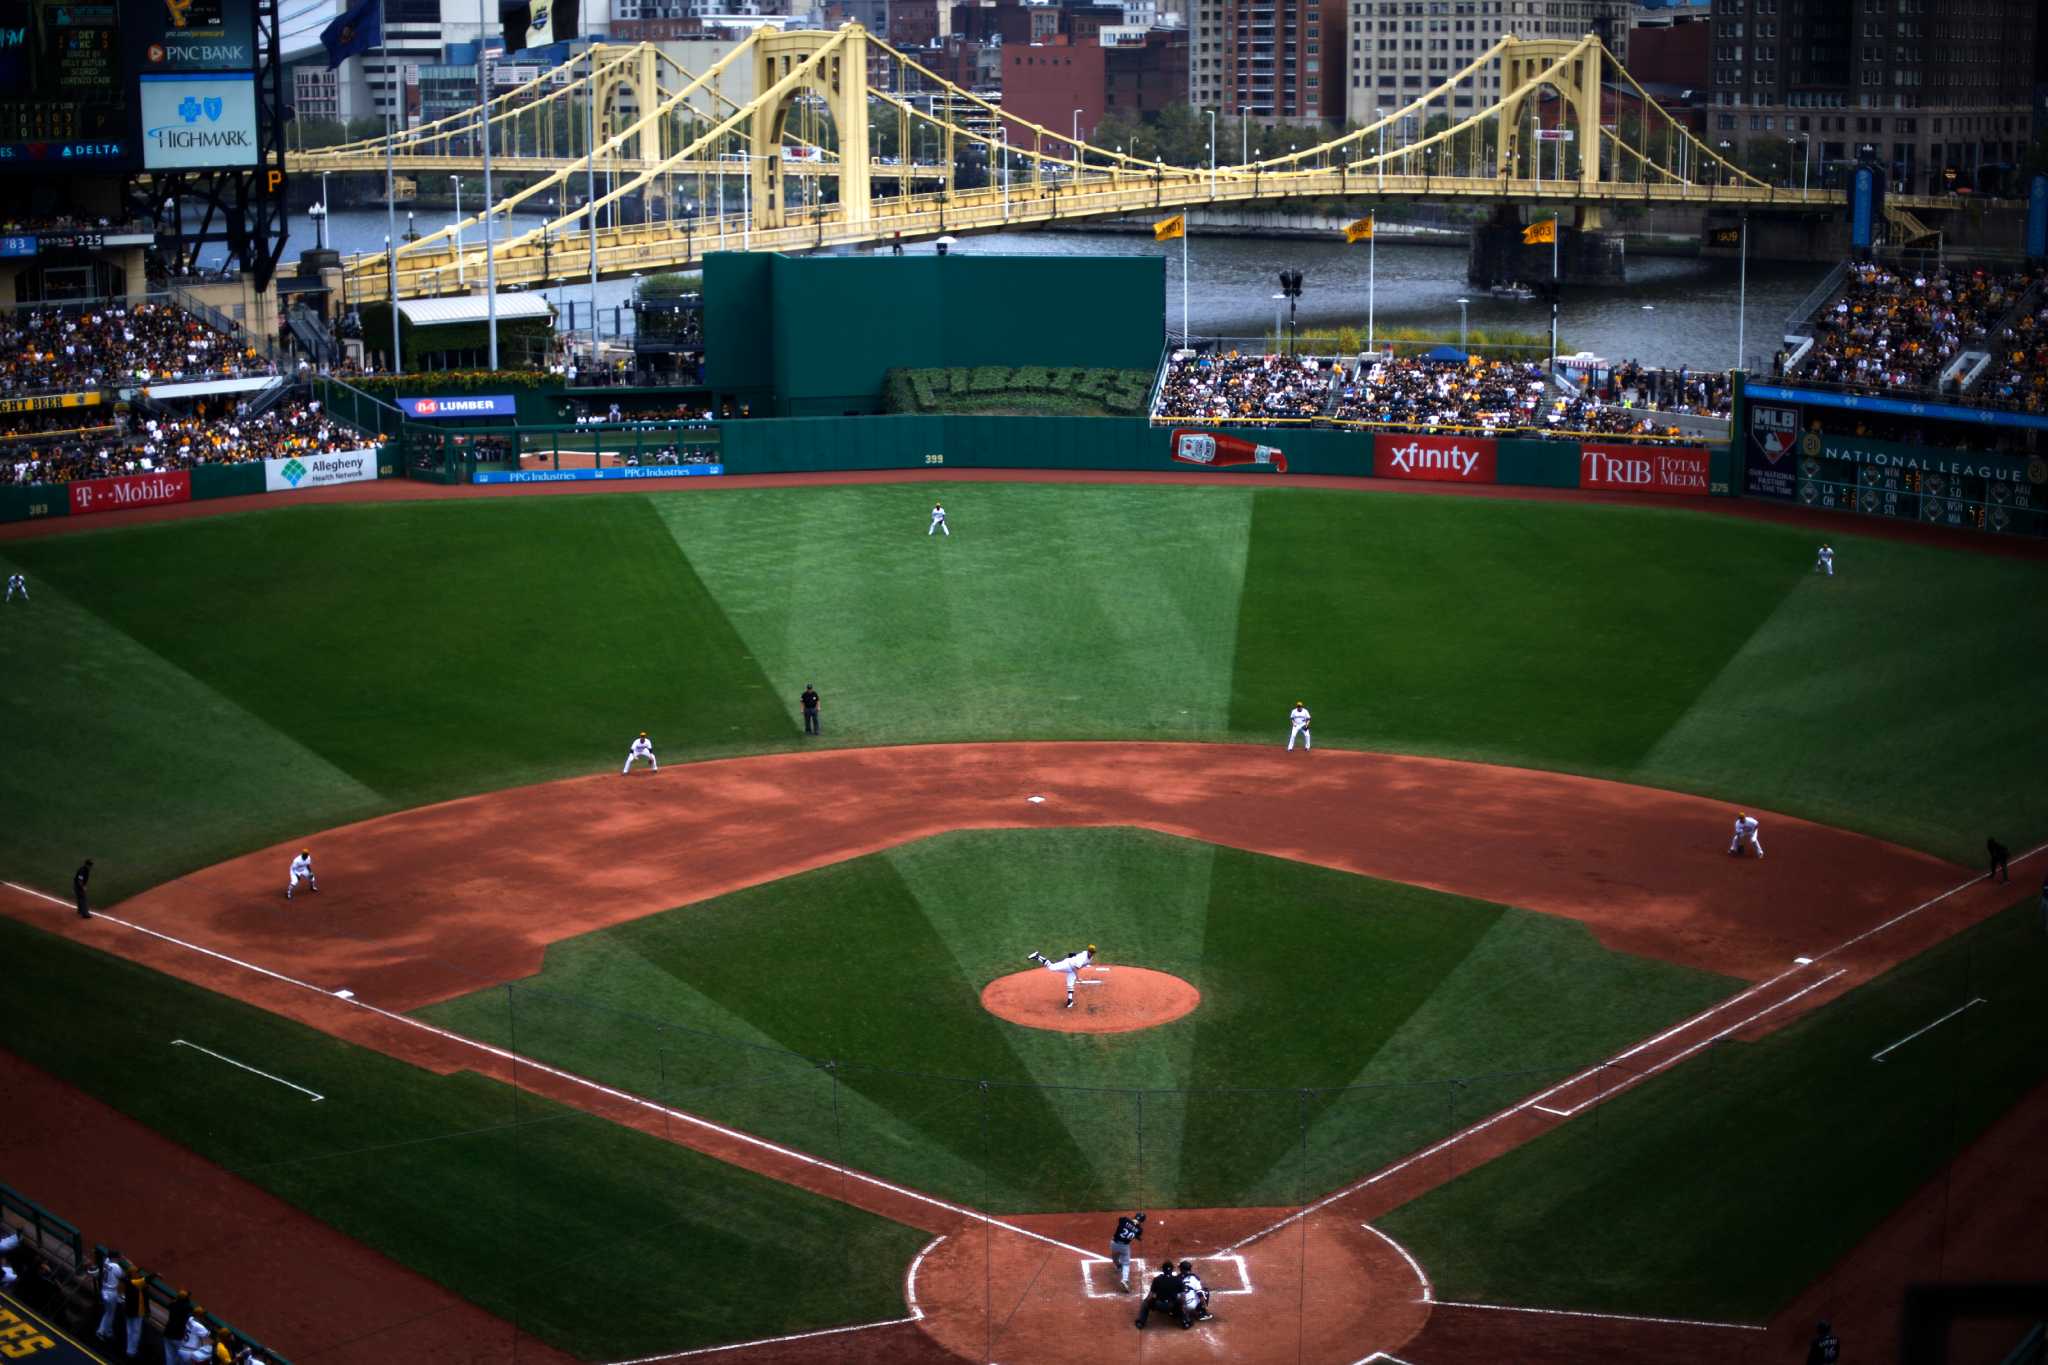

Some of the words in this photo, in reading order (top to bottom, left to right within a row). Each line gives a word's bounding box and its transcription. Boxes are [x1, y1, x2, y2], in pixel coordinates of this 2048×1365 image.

[166, 45, 200, 61] PNC
[202, 45, 244, 60] BANK
[158, 129, 249, 149] HIGHMARK
[76, 144, 120, 155] DELTA
[267, 170, 282, 192] P
[33, 395, 63, 409] BEER
[439, 400, 494, 411] LUMBER
[1755, 408, 1795, 428] MLB
[312, 458, 364, 472] Allegheny
[1391, 442, 1479, 476] xfinity
[1658, 455, 1706, 473] TOTAL
[1825, 447, 1931, 471] NATIONAL
[1939, 461, 2022, 482] LEAGUE
[510, 472, 531, 482] PPG
[531, 471, 577, 481] Industries
[625, 467, 645, 478] PPG
[646, 467, 690, 477] Industries
[1582, 452, 1651, 484] TRIB
[1661, 471, 1707, 488] MEDIA
